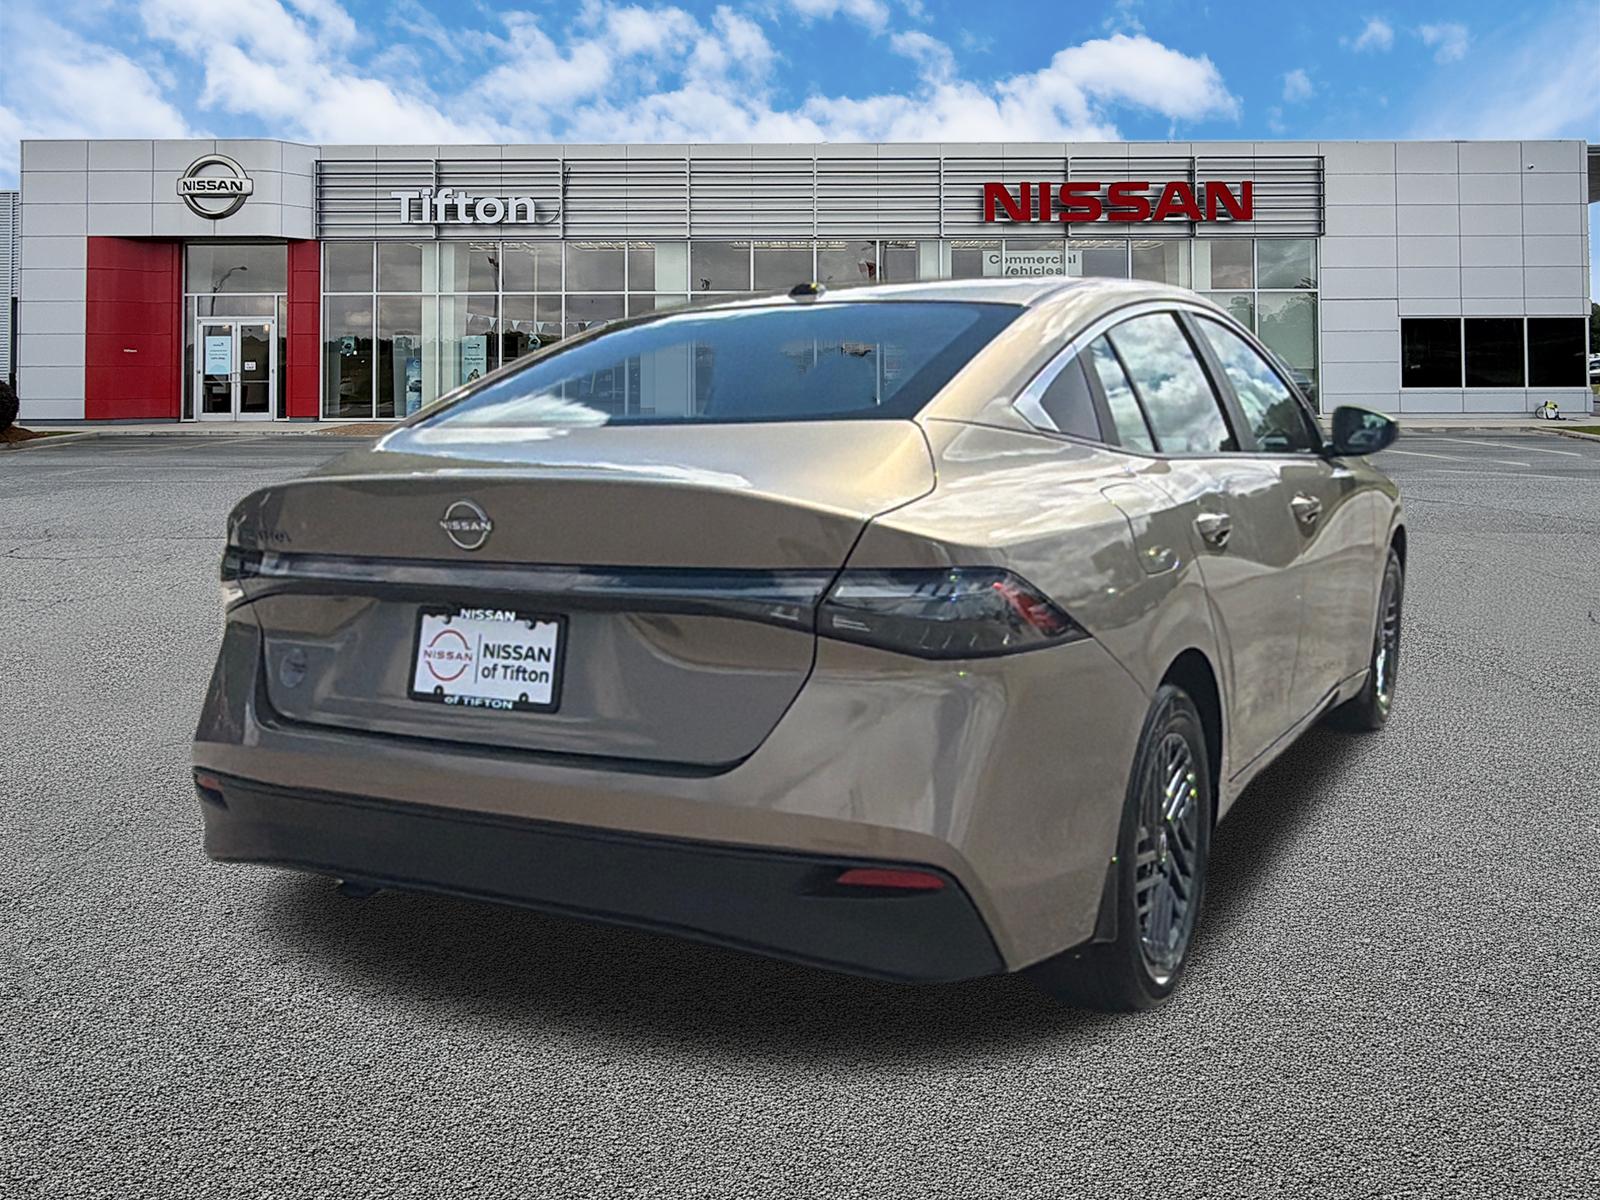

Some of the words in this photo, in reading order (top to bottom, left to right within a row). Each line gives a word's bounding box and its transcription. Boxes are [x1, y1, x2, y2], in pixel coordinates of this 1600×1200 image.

[183, 180, 243, 191] NISSAN
[391, 188, 536, 224] Tifton
[983, 181, 1254, 222] NISSAN
[440, 521, 491, 531] NISSAN
[460, 609, 516, 621] NISSAN
[424, 650, 473, 662] NISSAN
[483, 643, 552, 662] NISSAN
[482, 664, 498, 679] of
[502, 665, 549, 684] Tifton
[444, 696, 458, 704] of
[463, 697, 513, 710] TIFTON
